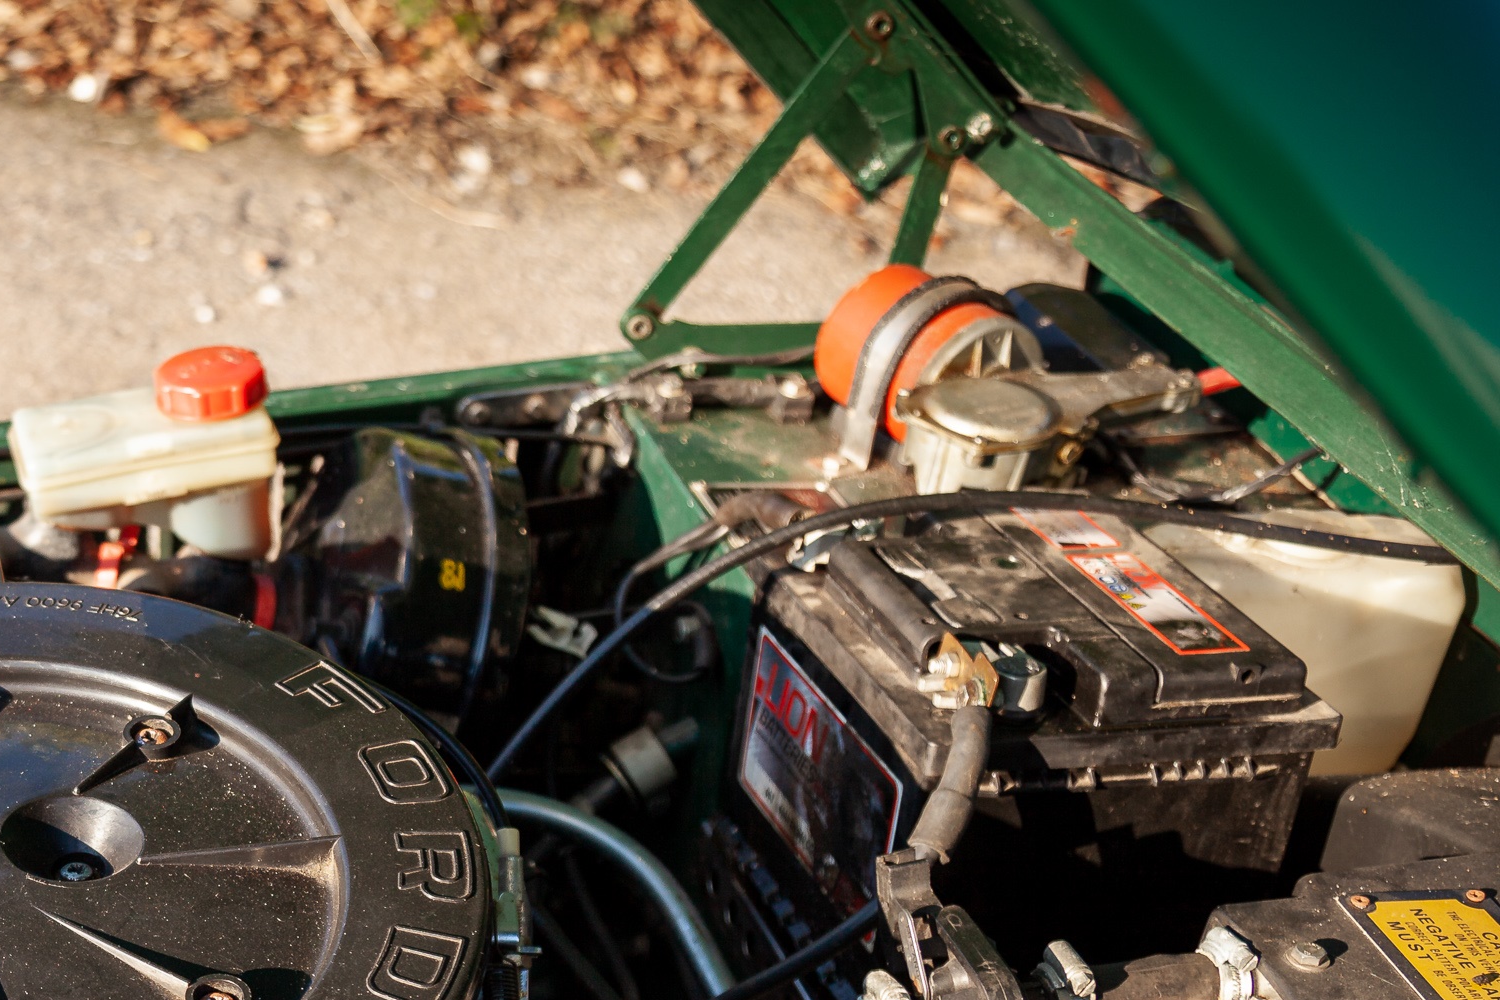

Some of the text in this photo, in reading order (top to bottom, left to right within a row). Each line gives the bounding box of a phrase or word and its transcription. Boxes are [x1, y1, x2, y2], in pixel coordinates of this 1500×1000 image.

[25, 597, 84, 612] 9600
[1386, 920, 1435, 962] MUST
[1433, 970, 1448, 979] BE
[1404, 922, 1434, 946] CORRECT
[1430, 948, 1460, 976] BATTERY
[1409, 908, 1476, 969] NEGATIVE
[1446, 911, 1463, 922] THE
[1457, 923, 1496, 957] ELECTRICAL
[1454, 933, 1469, 942] ON
[1464, 944, 1482, 957] THIS
